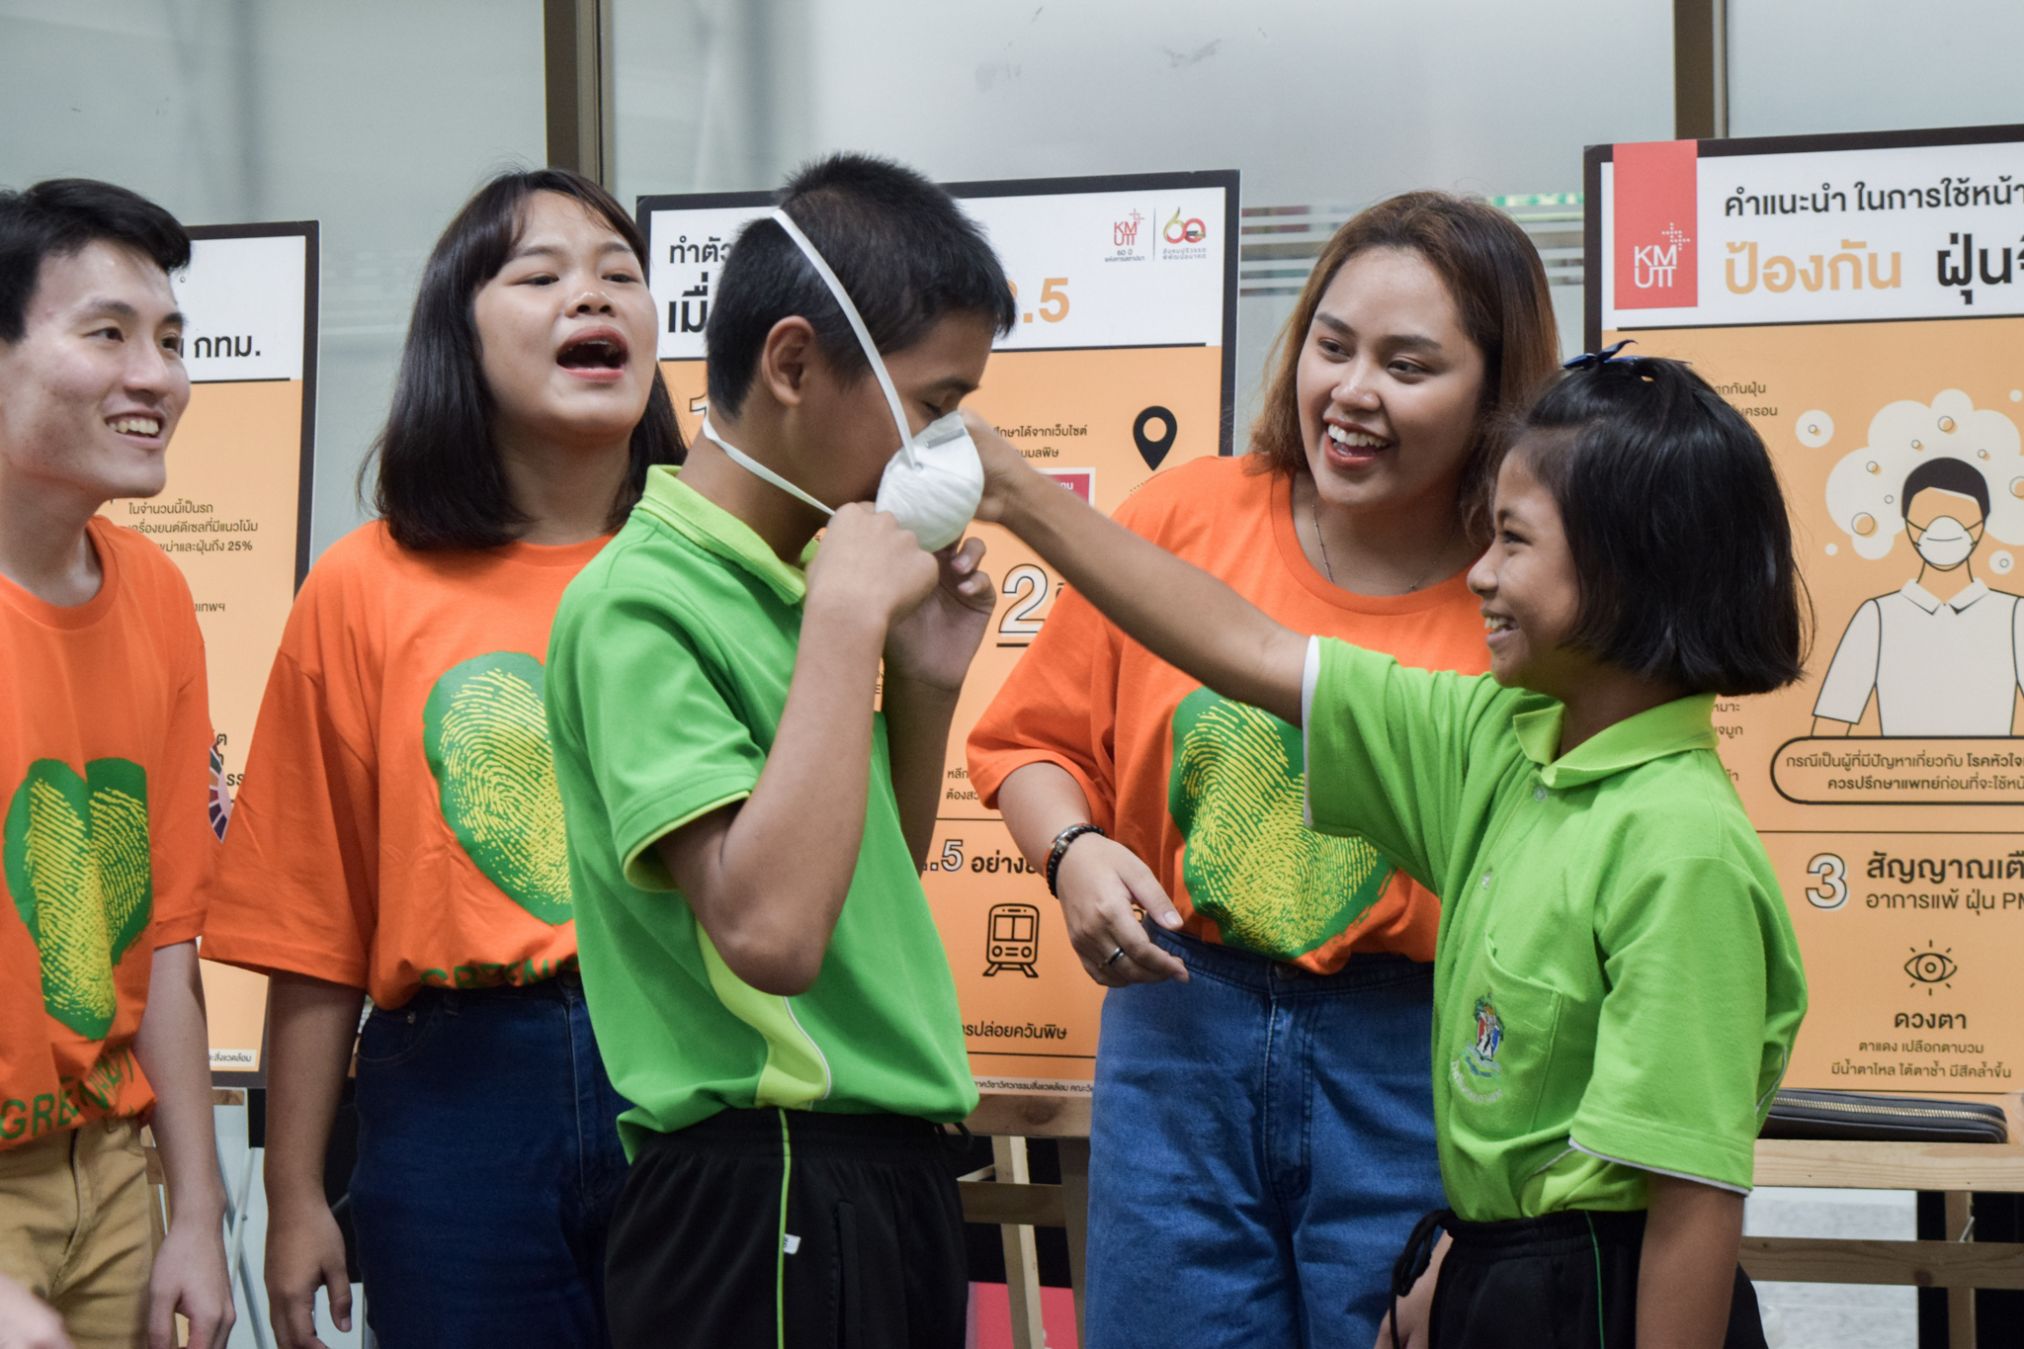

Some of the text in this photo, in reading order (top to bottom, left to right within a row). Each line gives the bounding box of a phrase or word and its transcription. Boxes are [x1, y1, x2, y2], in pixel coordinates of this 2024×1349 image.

[1724, 186, 1847, 217] คำแนะนำ
[1724, 232, 2024, 305] ป้องกัน ฝุ่น
[227, 540, 253, 552] 25%
[1966, 752, 2024, 768] โรคหัวใจ
[1805, 852, 1849, 910] 3
[1866, 888, 1960, 910] อาการแพ้
[1966, 888, 1996, 916] ฝุ่น
[1893, 1011, 1968, 1030] ดวงตา
